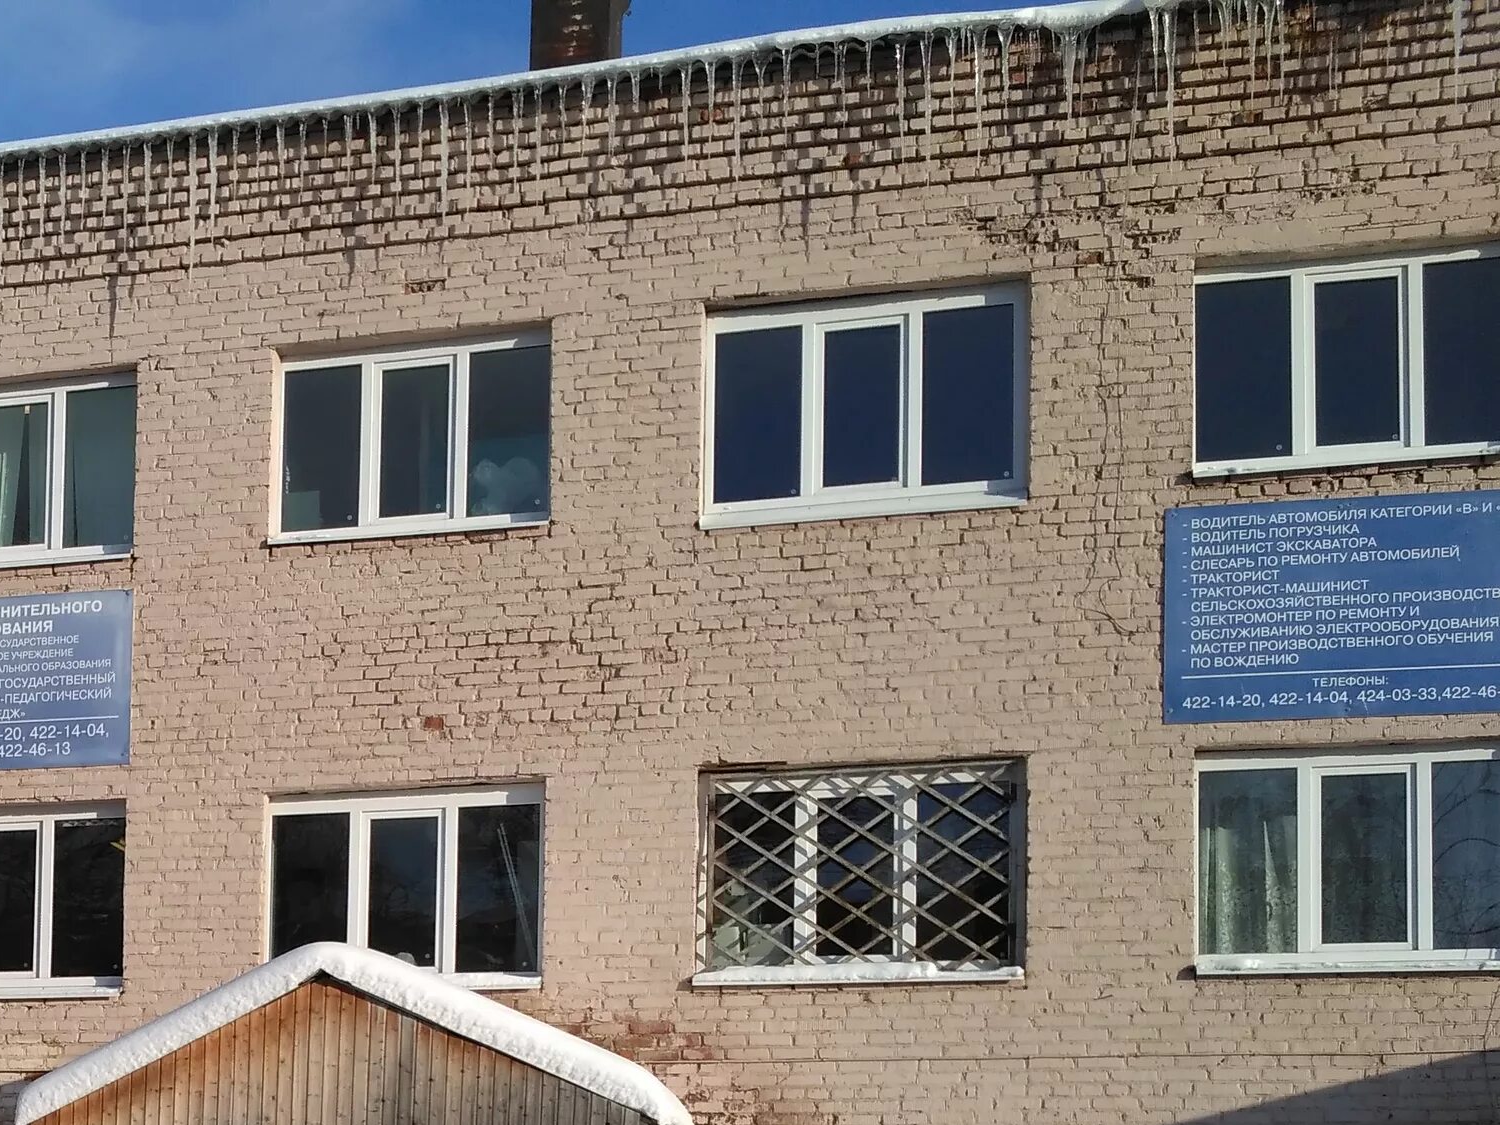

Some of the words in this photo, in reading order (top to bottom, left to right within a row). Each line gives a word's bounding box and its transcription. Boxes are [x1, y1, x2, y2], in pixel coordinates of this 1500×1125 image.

[1191, 514, 1266, 530] ВОДИТЕЛЬ
[1268, 508, 1366, 524] АВТОМОБИЛЯ
[1370, 503, 1452, 519] КАТЕГОРИИ
[1455, 503, 1478, 514] «В»
[1482, 502, 1492, 513] И
[1191, 528, 1266, 544] ВОДИТЕЛЬ
[1268, 523, 1360, 538] ПОГРУЗЧИКА
[1191, 541, 1274, 557] МАШИНИСТ
[1276, 536, 1377, 552] ЭКСКАВАТОРА
[1190, 557, 1255, 571] СЛЕСАРЬ
[1257, 555, 1278, 567] ПО
[1281, 552, 1348, 565] РЕМОНТУ
[1350, 544, 1459, 562] АВТОМОБИЛЕЙ
[1190, 569, 1280, 585] ТРАКТОРИСТ
[1190, 579, 1369, 598] ТРАКТОРИСТ-МАШИНИСТ
[1190, 592, 1389, 613] СЕЛЬСКОХОЗЯЙСТВЕННОГО
[1190, 610, 1312, 627] ЭЛЕКТРОМОНТЕР
[1315, 609, 1336, 620] ПО
[1339, 606, 1407, 619] РЕМОНТУ
[1409, 605, 1420, 616] И
[1190, 624, 1313, 641] ОБСЛУЖИВАНИЮ
[1315, 616, 1499, 635] ЭЛЕКТРООБОРУДОВАНИЯ
[1190, 641, 1246, 655] МАСТЕР
[1249, 634, 1414, 652] ПРОИЗВОДСТВЕННОГО
[1416, 630, 1493, 645] ОБУЧЕНИЯ
[11, 647, 73, 660] УЧРЕЖДЕНИЕ
[1190, 657, 1211, 669] ПО
[1214, 653, 1299, 668] ВОЖДЕНИЮ
[41, 658, 111, 671] ОБРАЗОВАНИЯ
[1311, 675, 1388, 687] ТЕЛЕФОНЫ:
[1182, 694, 1265, 709] 422-14-20,
[1268, 690, 1352, 705] 422-14-04,
[29, 722, 109, 739] 422-14-04,
